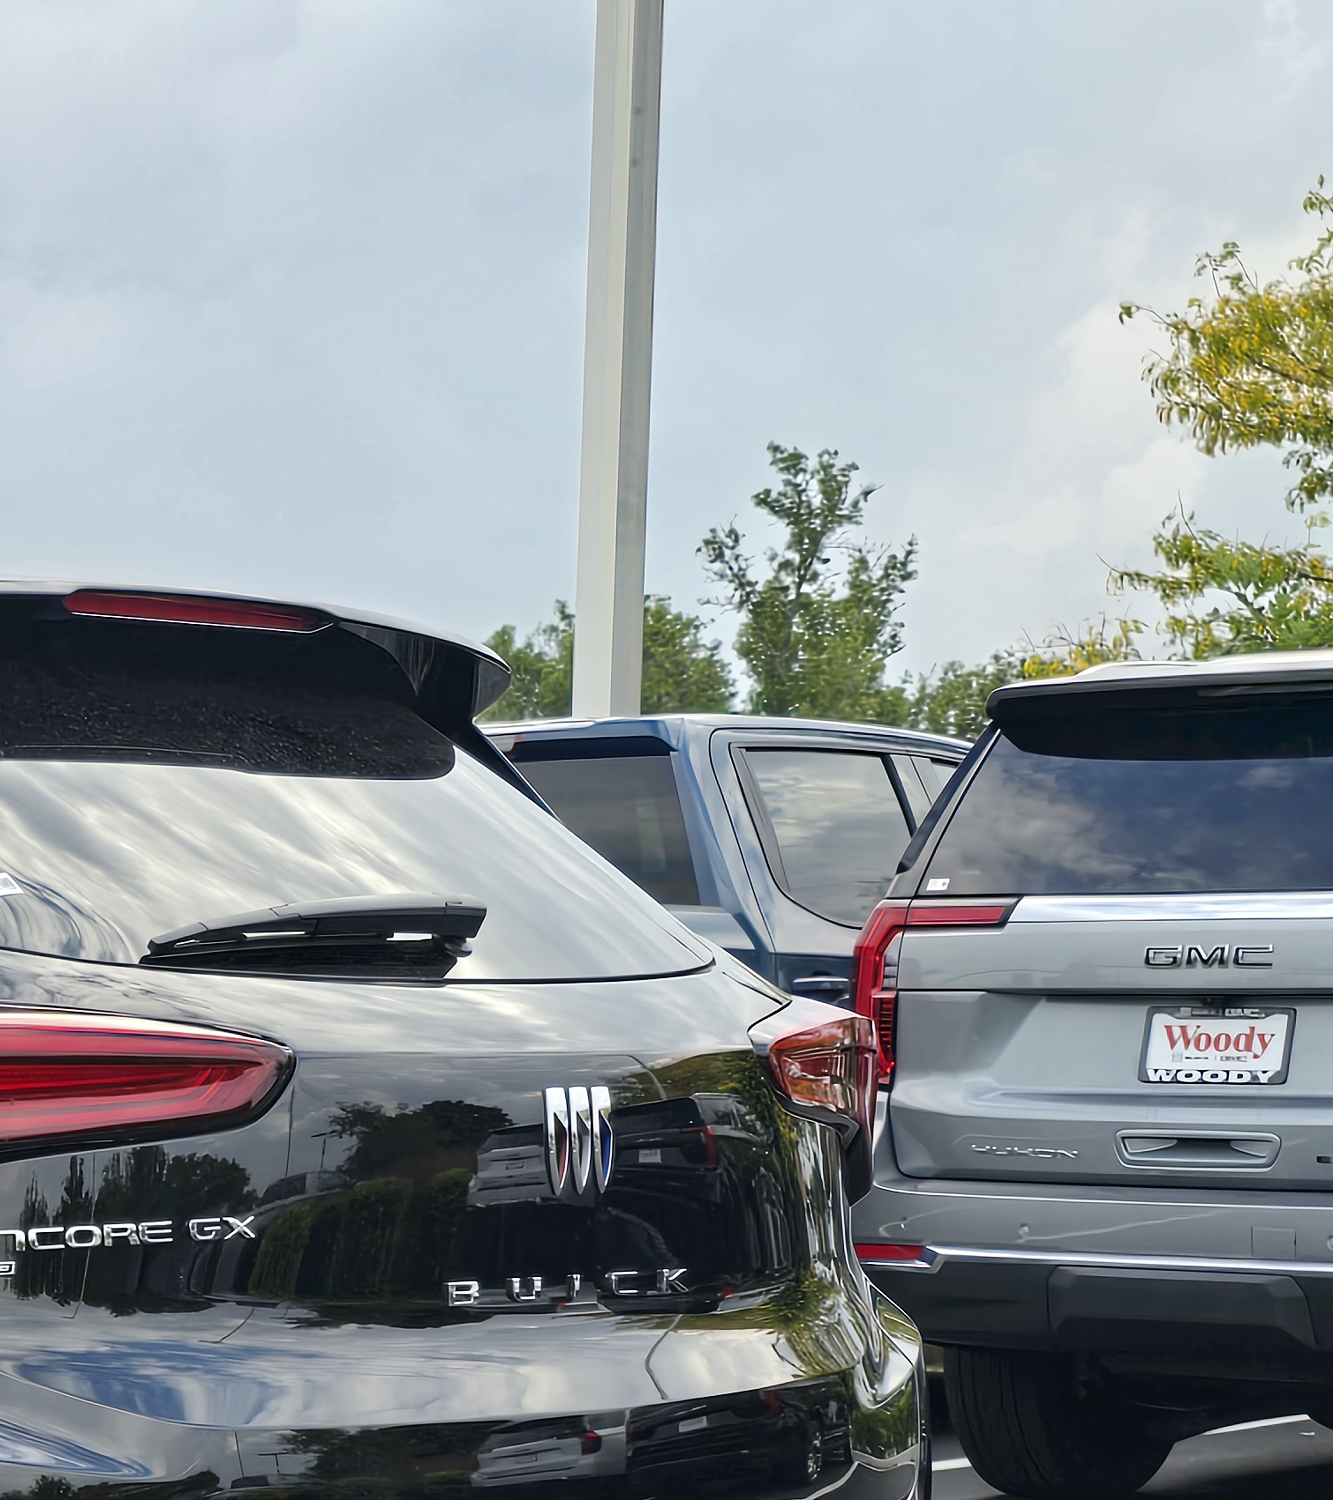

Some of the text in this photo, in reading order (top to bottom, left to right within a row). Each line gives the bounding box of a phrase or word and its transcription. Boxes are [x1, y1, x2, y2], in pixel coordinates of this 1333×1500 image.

[1144, 944, 1274, 969] GMC
[1163, 1025, 1276, 1060] Woody
[1146, 1068, 1281, 1084] WOODY
[187, 1214, 257, 1242] GX
[444, 1267, 689, 1307] BUICK
